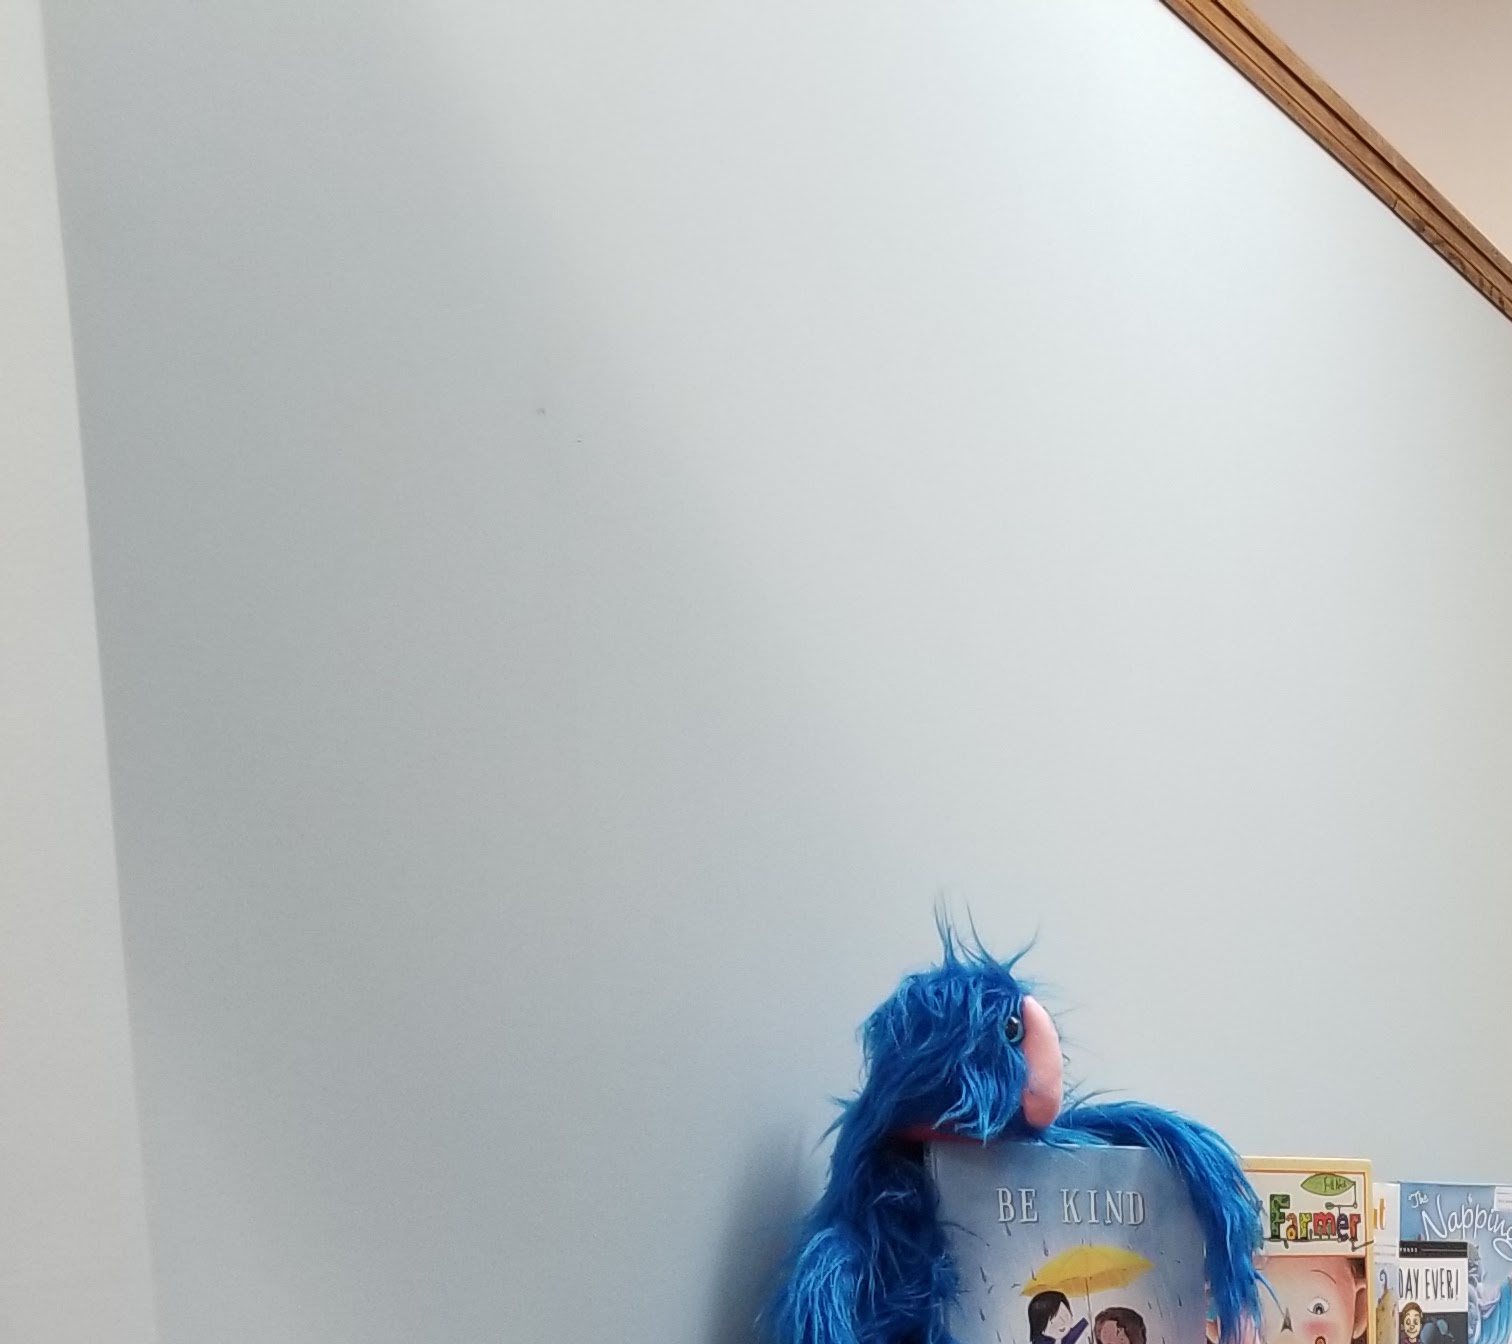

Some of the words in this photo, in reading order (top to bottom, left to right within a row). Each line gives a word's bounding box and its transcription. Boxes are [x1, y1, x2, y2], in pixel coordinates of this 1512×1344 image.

[996, 1187, 1038, 1225] BE
[1061, 1189, 1147, 1227] KIND
[1408, 1190, 1428, 1209] The
[1269, 1194, 1361, 1242] Farmer
[1425, 1268, 1459, 1300] EVER!
